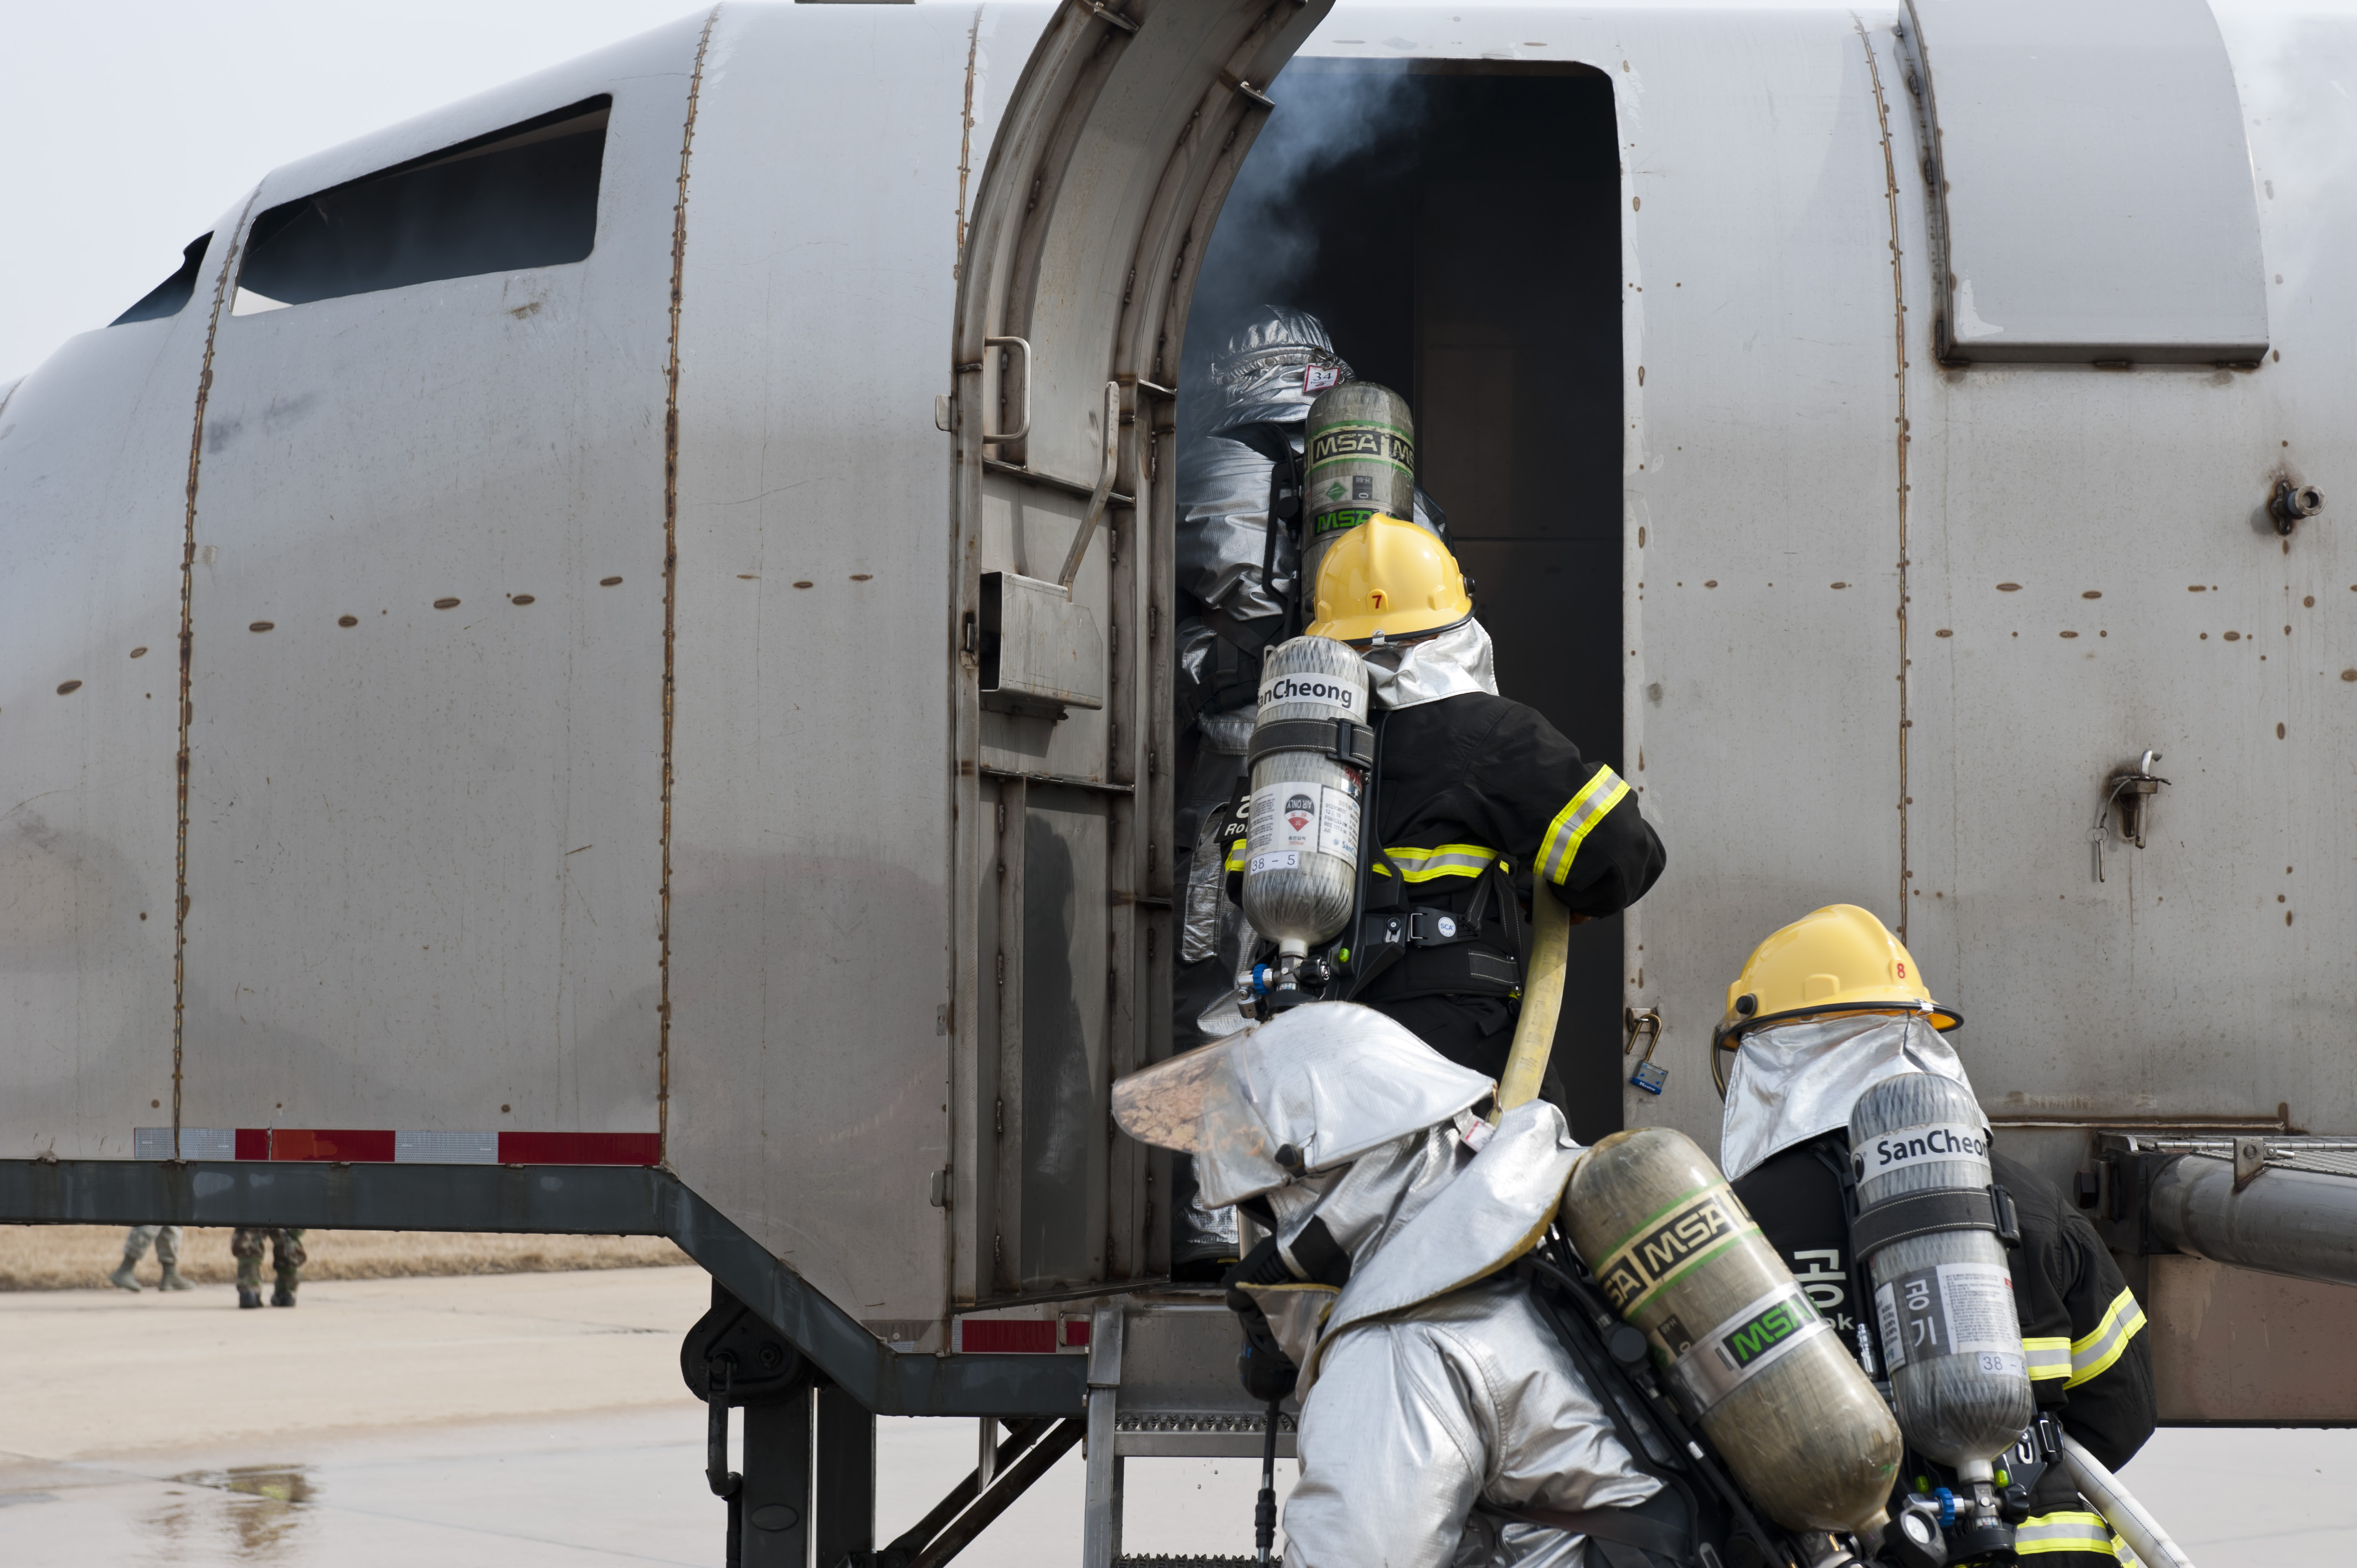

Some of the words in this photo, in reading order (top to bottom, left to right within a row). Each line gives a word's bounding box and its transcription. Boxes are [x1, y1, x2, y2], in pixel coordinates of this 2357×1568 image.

[1313, 372, 1332, 381] 34
[1316, 434, 1378, 459] MSA
[1316, 510, 1373, 534] MSA
[1372, 595, 1382, 609] 7
[1287, 800, 1301, 809] ONLY
[1303, 800, 1313, 809] AIR
[1224, 823, 1248, 836] Ro
[1252, 858, 1264, 871] 38
[1287, 854, 1295, 865] 5
[1897, 963, 1906, 979] 8
[1639, 1081, 1656, 1091] Master
[1603, 1268, 1641, 1308] SA
[1644, 1203, 1732, 1273] MSA
[1905, 1278, 1937, 1347] 공기
[1732, 1298, 1813, 1361] MSA
[1983, 1356, 2003, 1370] 38
[2021, 1361, 2026, 1376] 6
